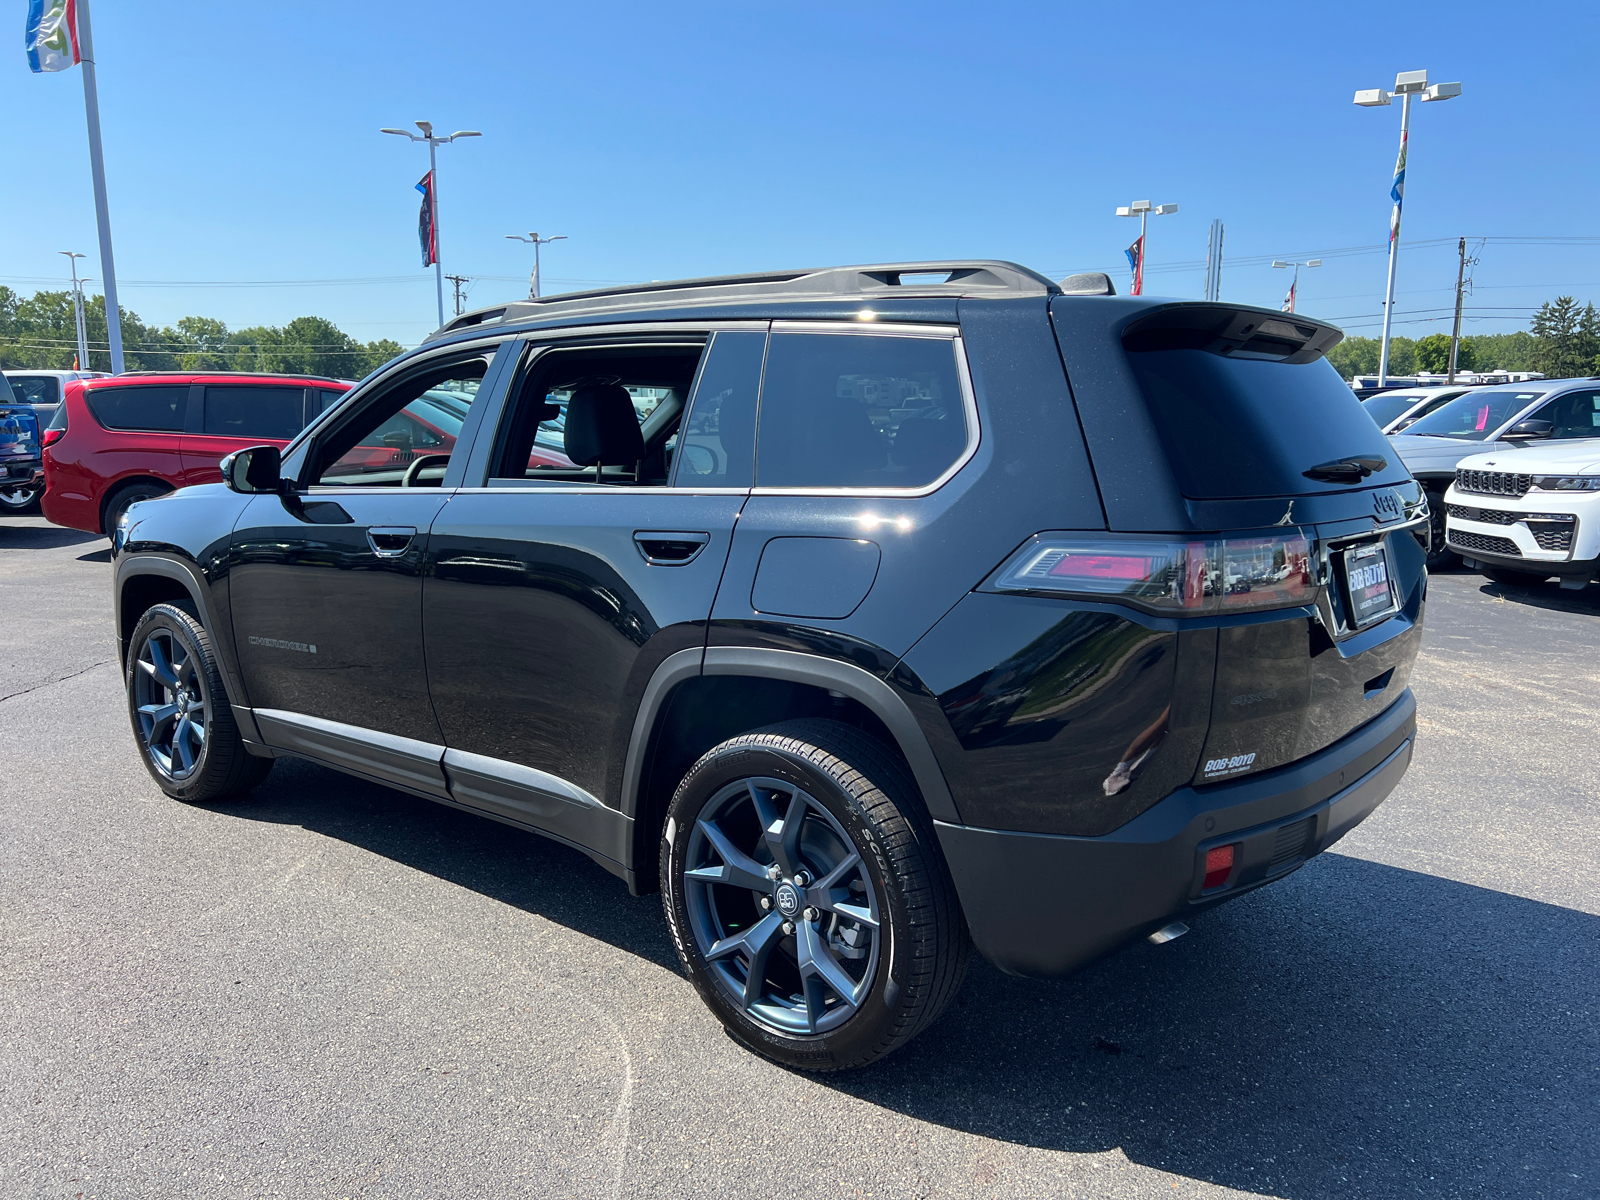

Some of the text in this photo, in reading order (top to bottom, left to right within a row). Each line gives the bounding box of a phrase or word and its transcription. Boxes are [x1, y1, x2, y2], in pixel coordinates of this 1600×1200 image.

[0, 426, 22, 435] AM
[1372, 492, 1399, 515] Jeep
[248, 635, 309, 653] CHEROKEE
[1204, 752, 1256, 772] BOB-BOYD
